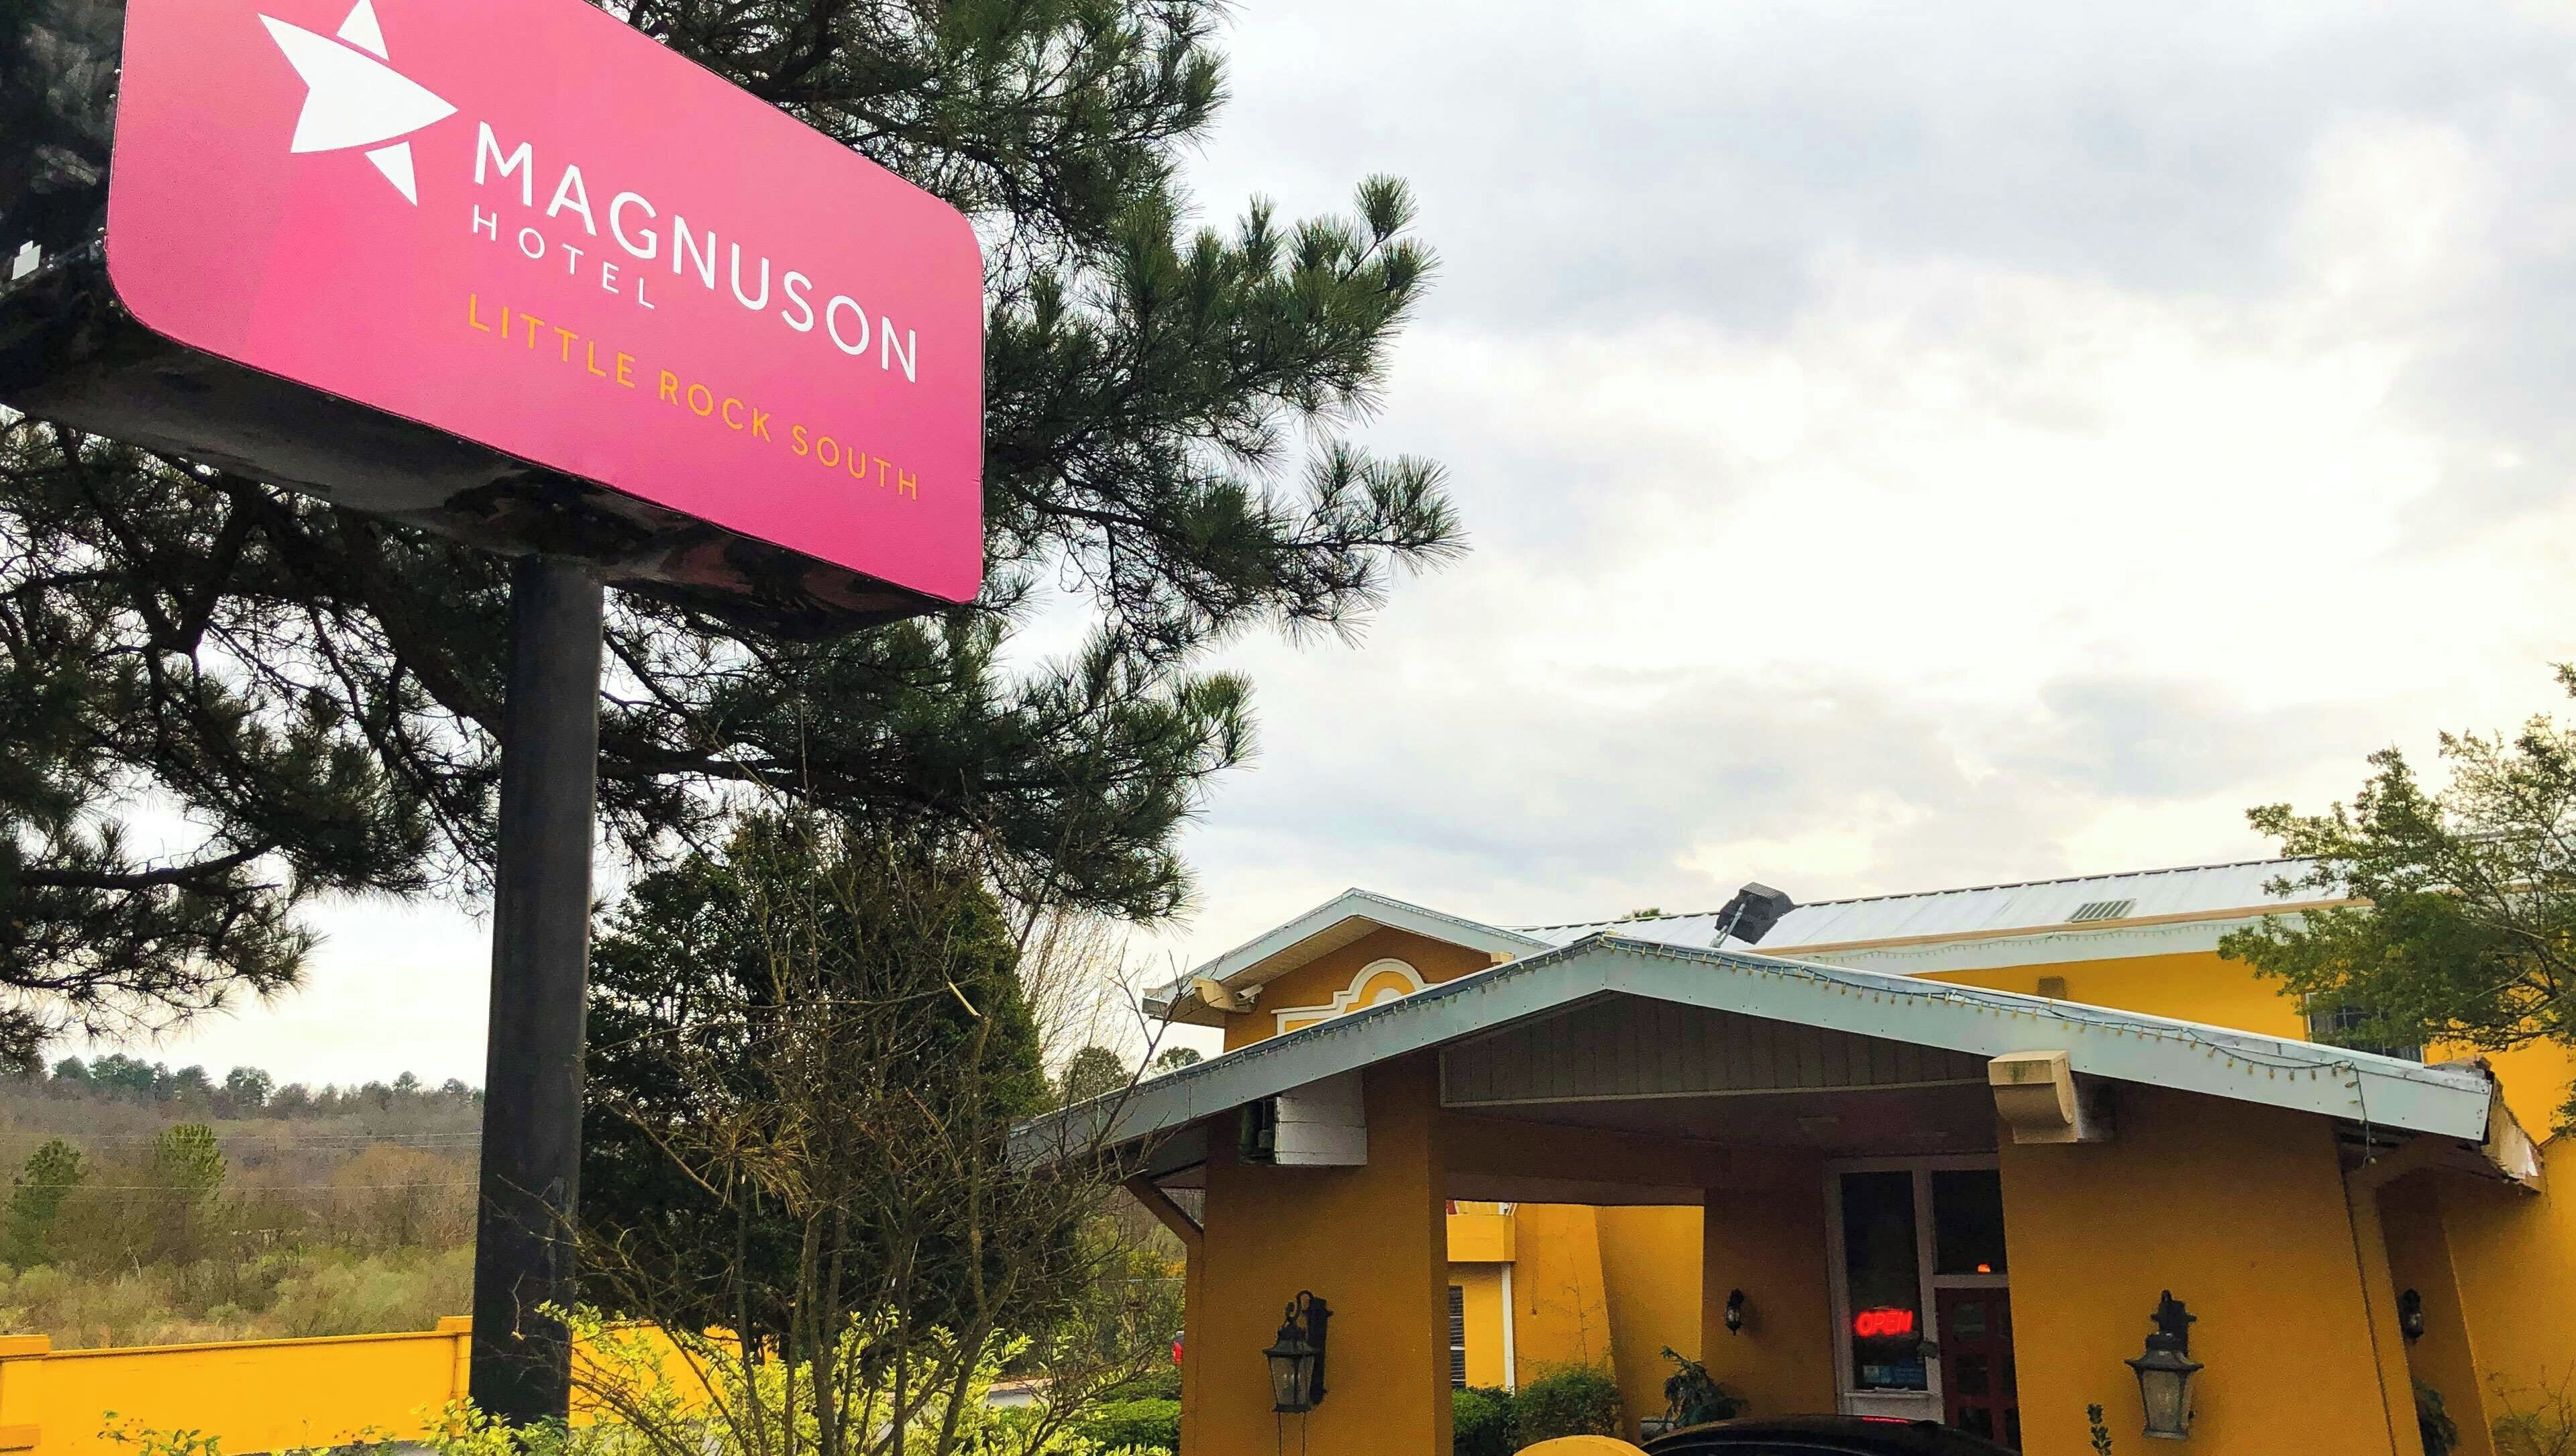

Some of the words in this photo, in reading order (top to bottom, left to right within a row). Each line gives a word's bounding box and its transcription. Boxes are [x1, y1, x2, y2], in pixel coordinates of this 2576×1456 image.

[472, 204, 655, 310] HOTEL
[474, 121, 916, 383] MAGNUSON
[468, 293, 636, 388] LITTLE
[659, 370, 771, 443] ROCK
[790, 425, 918, 501] SOUTH
[1856, 1309, 1913, 1337] OPEN
